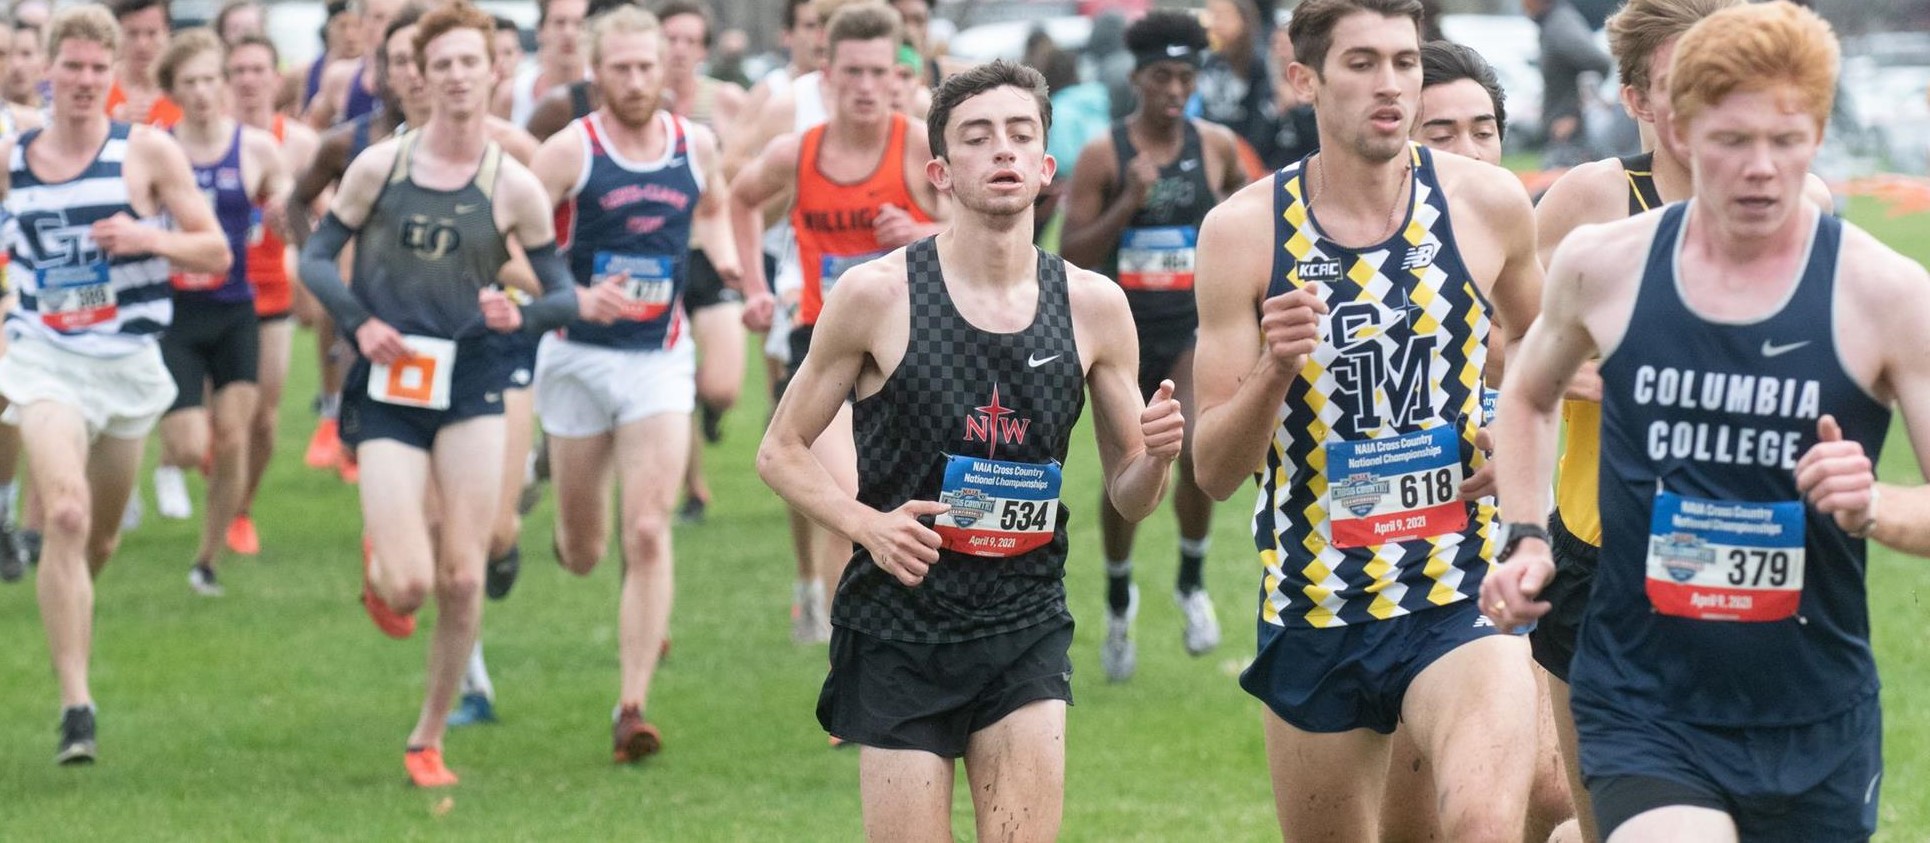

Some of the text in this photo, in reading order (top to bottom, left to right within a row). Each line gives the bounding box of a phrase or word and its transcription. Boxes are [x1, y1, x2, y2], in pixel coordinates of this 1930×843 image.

[1298, 261, 1340, 278] KCAC
[1633, 364, 1821, 420] COLUMBIA
[1354, 434, 1433, 455] NAIA Cross Country
[1647, 419, 1802, 471] COLLEGE
[1348, 445, 1442, 469] National Championships
[973, 461, 1044, 479] NAIA Cross Country
[964, 473, 1048, 491] National Championships
[1400, 468, 1453, 509] 618
[1000, 500, 1049, 531] 534
[1734, 505, 1774, 521] Country
[1374, 520, 1396, 536] April
[1406, 515, 1426, 530] 2021
[968, 535, 1016, 548] April 9, 2021
[1728, 549, 1788, 587] 379
